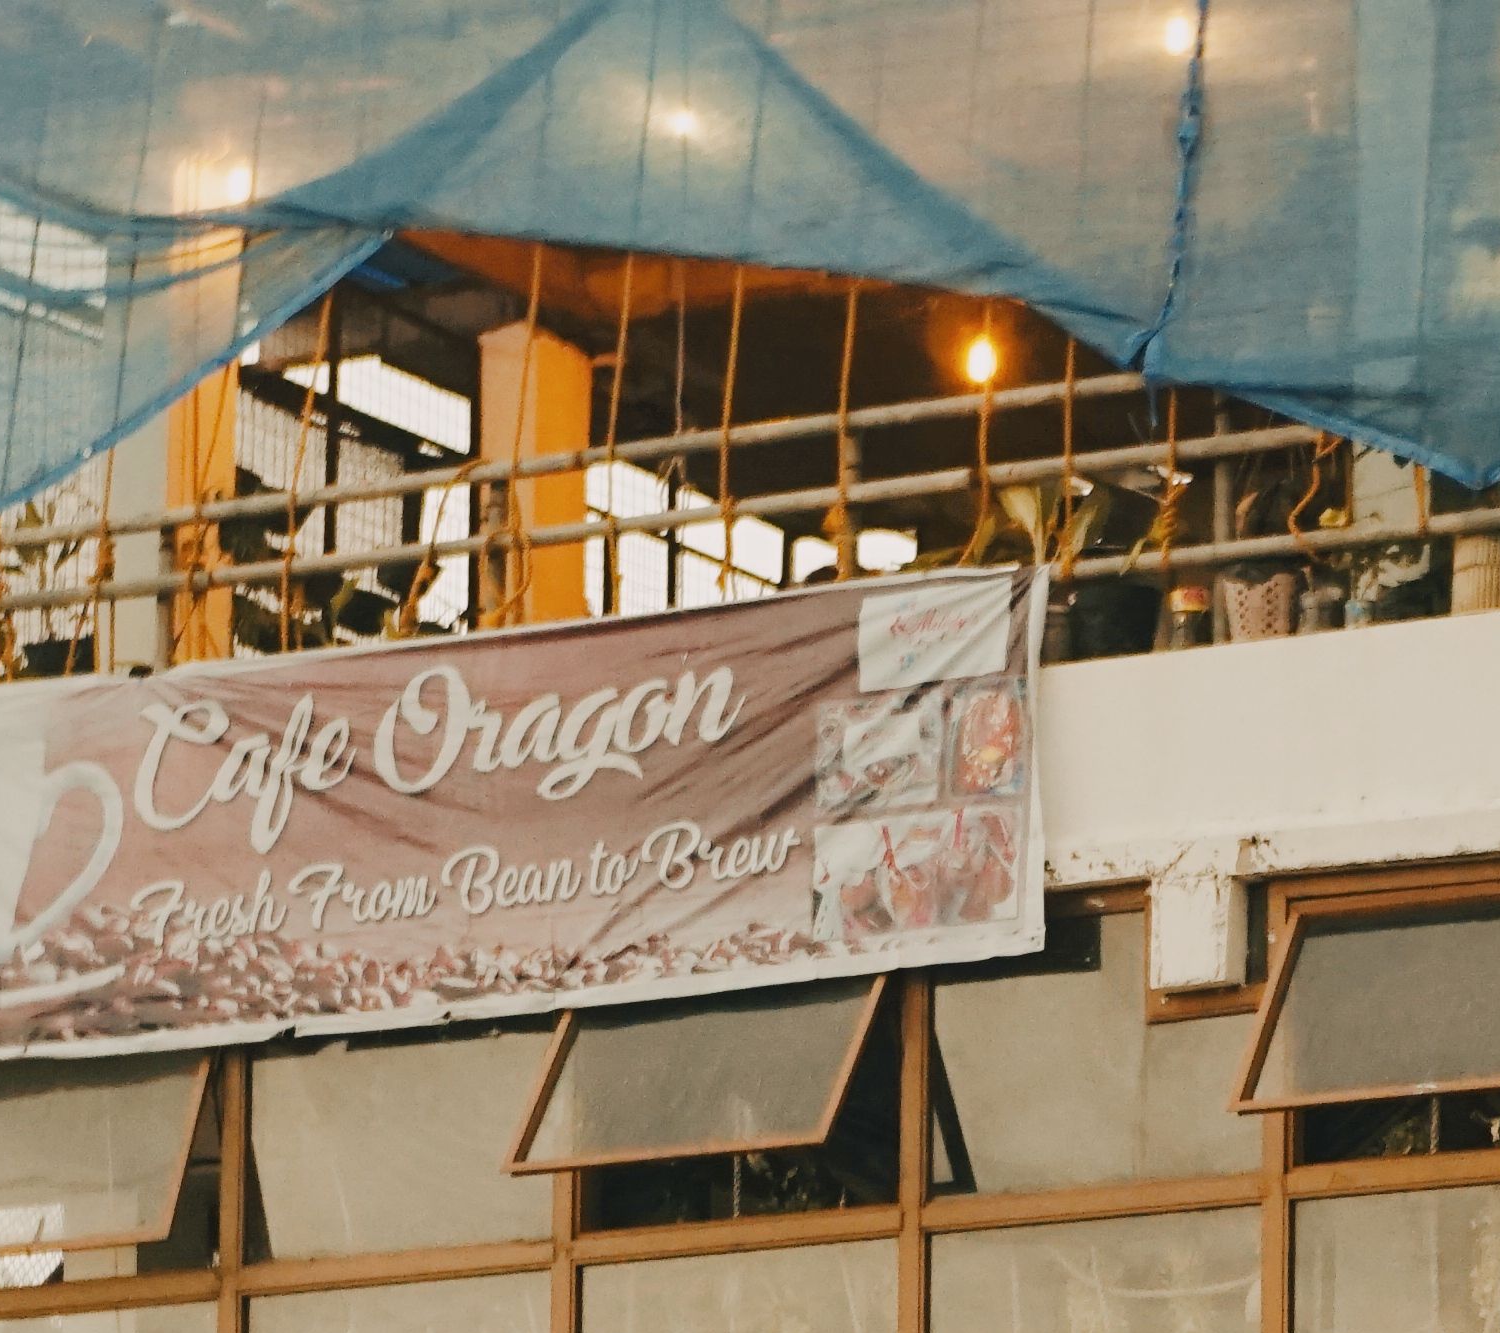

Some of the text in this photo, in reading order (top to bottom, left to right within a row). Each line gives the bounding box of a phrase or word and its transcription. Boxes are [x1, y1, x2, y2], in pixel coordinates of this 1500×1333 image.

[134, 664, 745, 854] Cafe Oragon
[132, 821, 800, 944] Fresh From Bean to Brew
